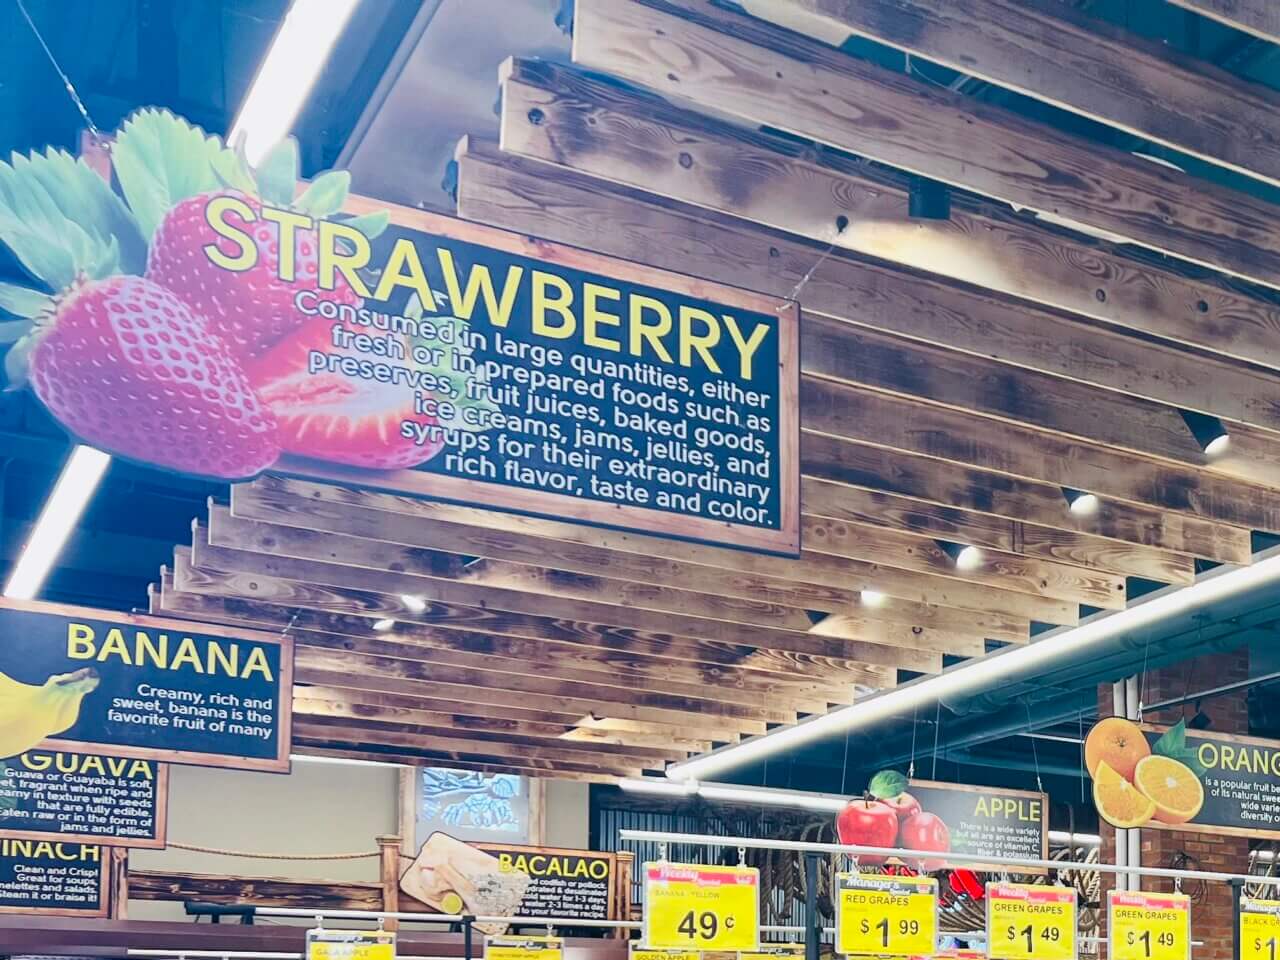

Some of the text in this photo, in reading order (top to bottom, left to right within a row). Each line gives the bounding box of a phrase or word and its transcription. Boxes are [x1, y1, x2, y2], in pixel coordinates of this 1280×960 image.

[204, 196, 769, 381] STRAWBERRY
[295, 291, 770, 409] Consumed in large quantities, either
[332, 325, 770, 432] fresh or in prepared foods such as
[308, 350, 771, 458] preserves, fruit juices, baked goods,
[415, 391, 770, 478] ice creams, jams, jellies, and
[401, 420, 770, 505] syrups for their extraordinary
[445, 451, 773, 526] rich flavor, taste and color.
[66, 623, 274, 682] BANANA
[137, 683, 273, 711] Creamy, rich and
[112, 696, 273, 725] sweet, banana is the
[108, 709, 273, 740] favorite fruit of many
[20, 752, 153, 779] GUAVA
[4, 767, 44, 781] Guava
[46, 771, 60, 781] or
[62, 773, 115, 789] Guayaba
[117, 777, 127, 788] is
[19, 779, 153, 799] fragrant when ripe and
[1220, 779, 1252, 792] popular
[1253, 782, 1270, 791] fruit
[33, 790, 153, 808] in texture with seeds
[1211, 787, 1220, 797] of
[1222, 788, 1230, 798] its
[1231, 789, 1260, 801] natural
[37, 801, 61, 811] that
[63, 803, 84, 812] are
[86, 803, 111, 816] fully
[974, 796, 1041, 822] APPLE
[1240, 801, 1260, 811] wide
[33, 811, 153, 827] raw or in the form of
[60, 822, 89, 833] jams
[91, 823, 114, 834] and
[1240, 812, 1273, 824] diversity
[13, 864, 45, 874] Clean
[47, 865, 67, 875] and
[499, 853, 608, 880] BACALAO
[16, 873, 47, 883] Great
[49, 874, 64, 884] for
[845, 894, 909, 907] RED GRAPES
[994, 903, 1063, 916] GREEN GRAPES
[1115, 910, 1178, 922] GREEN GRAPES
